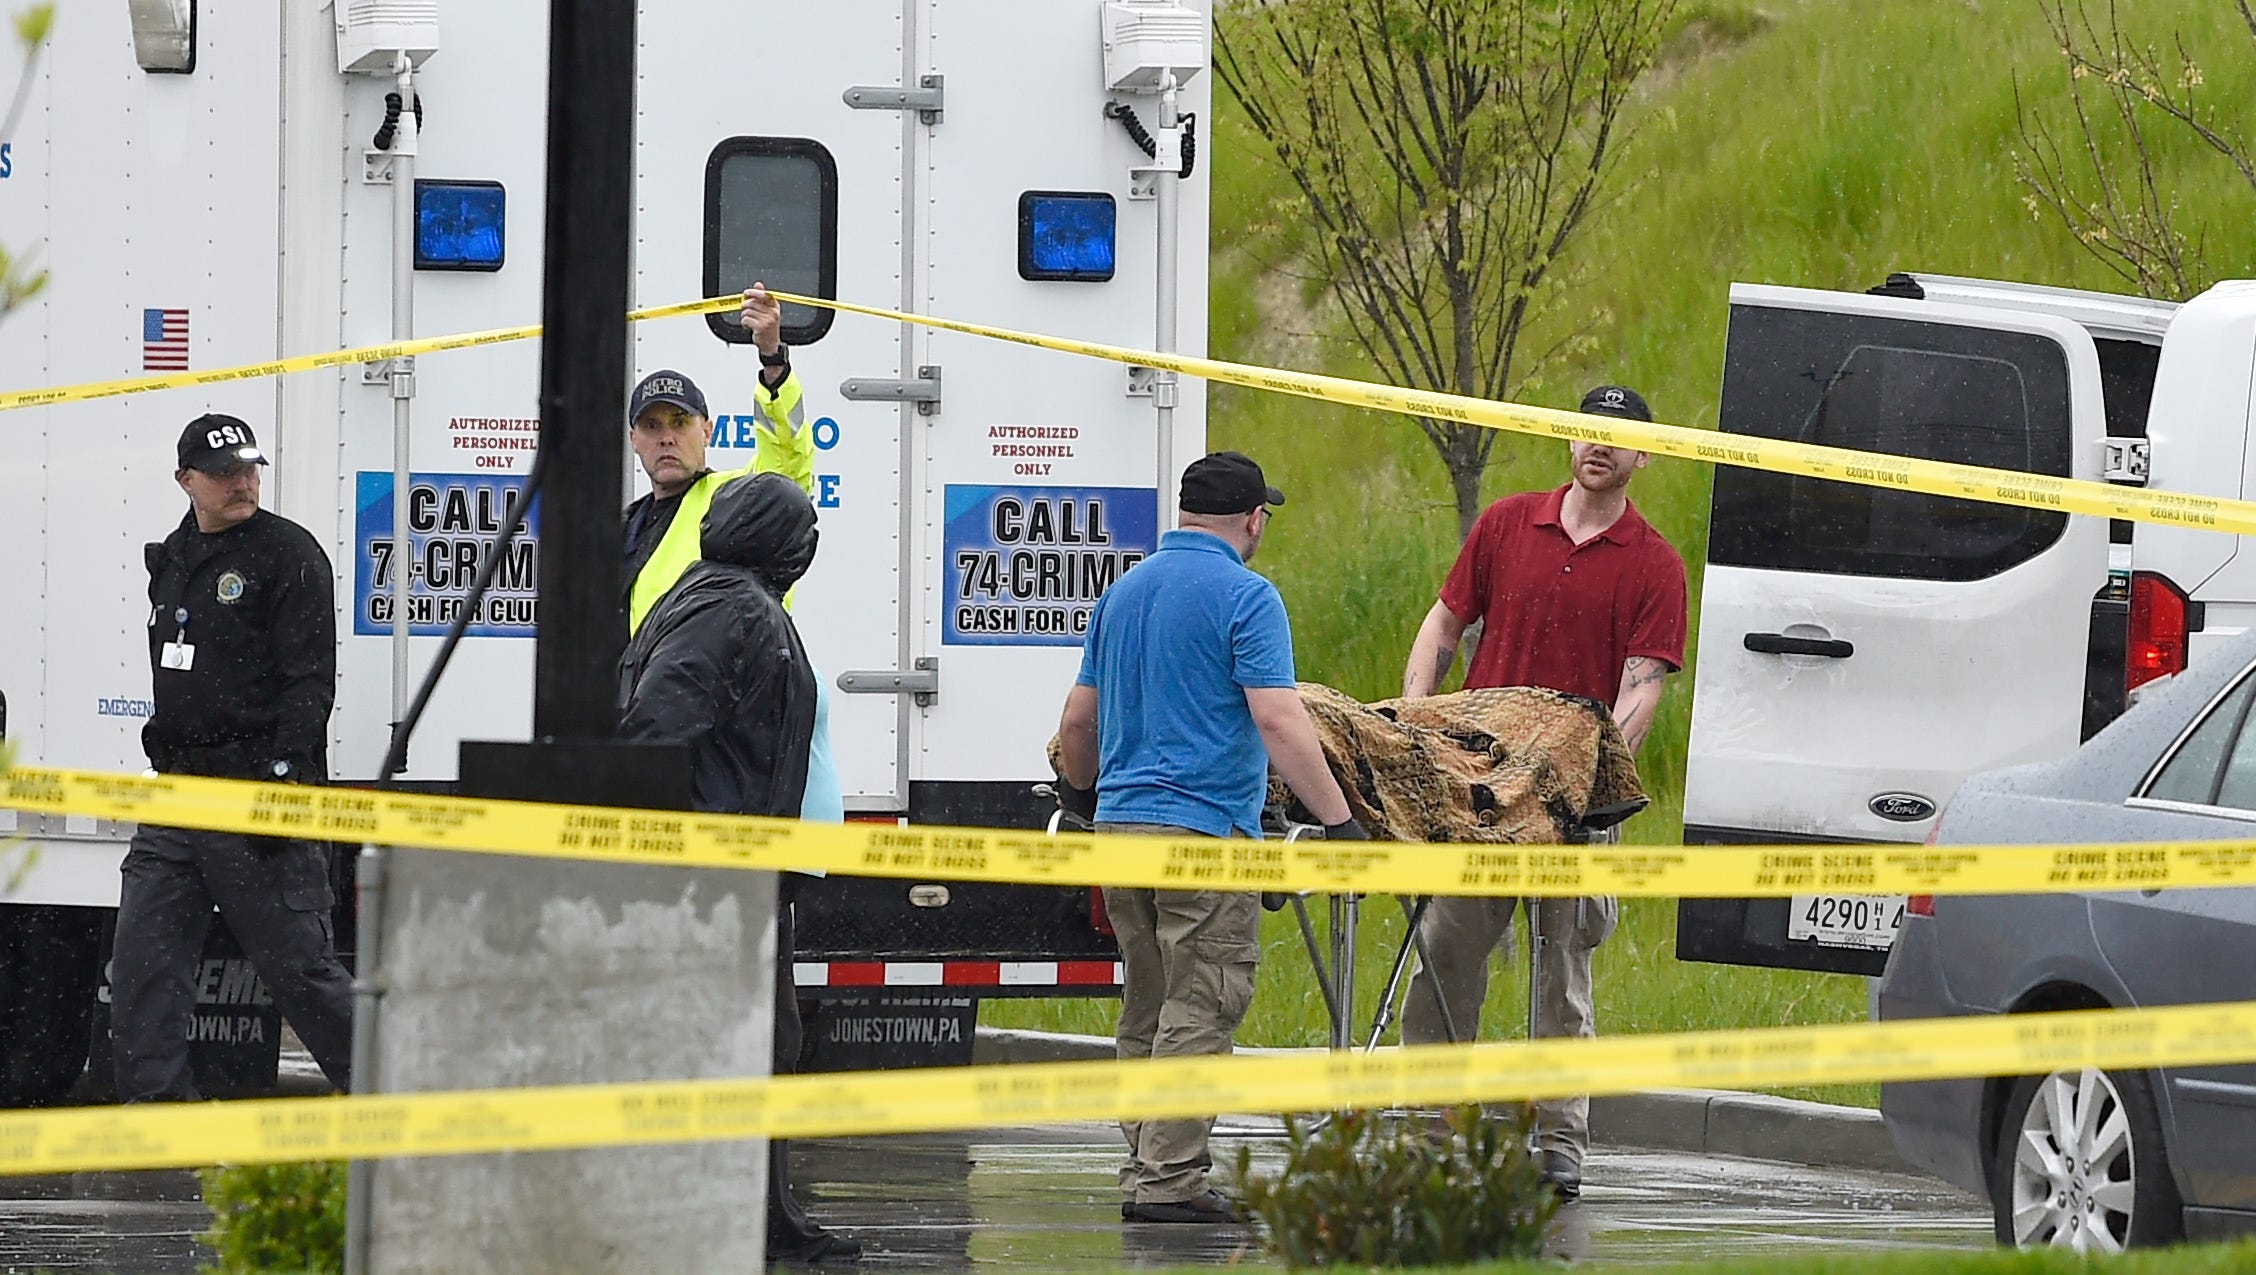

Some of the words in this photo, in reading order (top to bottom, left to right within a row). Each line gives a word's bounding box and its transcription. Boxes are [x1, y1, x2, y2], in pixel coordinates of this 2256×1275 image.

[641, 385, 685, 401] POLICE
[643, 377, 683, 391] METRO
[448, 418, 541, 431] AUTHORIZED
[710, 415, 839, 450] MEO
[988, 426, 1079, 439] AUTHORIZED
[206, 425, 247, 449] CSI
[453, 437, 537, 450] PERSONNEL
[992, 445, 1074, 457] PERSONNEL
[475, 456, 514, 468] ONLY
[1014, 463, 1052, 475] ONLY
[409, 487, 528, 535] CALL
[995, 499, 1109, 544] CALL
[369, 539, 539, 591] 7-CRIM
[488, 598, 539, 625] CLU
[957, 607, 1017, 632] CASH
[1023, 609, 1067, 634] FOR
[1884, 797, 1920, 815] Ford
[1806, 897, 1868, 930] 4290
[831, 1017, 960, 1047] JONESTOWN,PA
